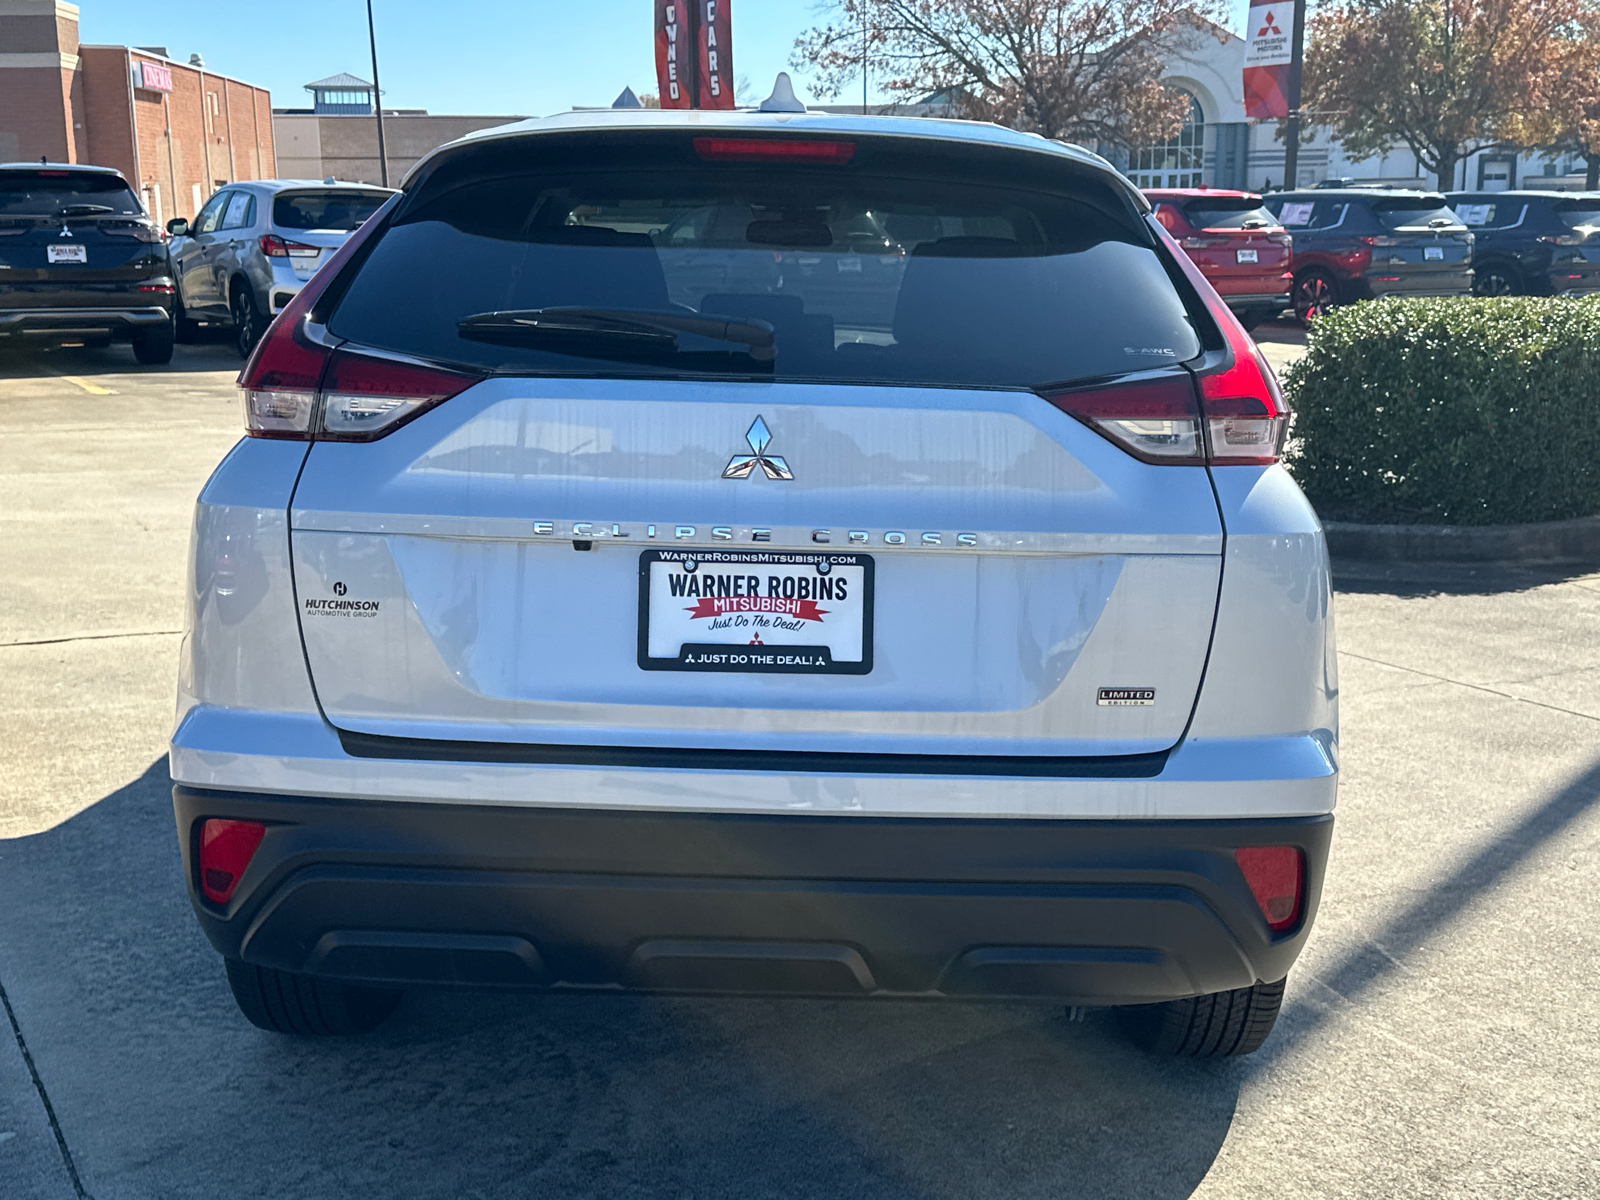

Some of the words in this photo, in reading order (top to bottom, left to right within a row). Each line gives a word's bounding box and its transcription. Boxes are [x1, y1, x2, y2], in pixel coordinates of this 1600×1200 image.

[706, 1, 720, 96] CARS
[1252, 37, 1287, 46] MITSUBISHI
[1257, 44, 1283, 53] MOTORS
[665, 5, 680, 100] OWNED
[143, 65, 173, 91] CINEMAS
[533, 521, 772, 543] ECLIPSE
[811, 528, 978, 547] CROSS
[668, 573, 761, 598] WARNER
[767, 575, 848, 601] ROBINS
[305, 599, 380, 611] HUTCHINSON
[713, 598, 801, 614] MITSUBISHI
[707, 614, 732, 631] Just
[734, 614, 749, 628] Do
[752, 614, 771, 628] The
[772, 618, 806, 632] Deal!
[697, 653, 727, 664] JUST
[730, 654, 748, 664] DO
[750, 654, 774, 665] THE
[777, 654, 813, 666] DEAL!
[1101, 691, 1153, 699] LIMITED
